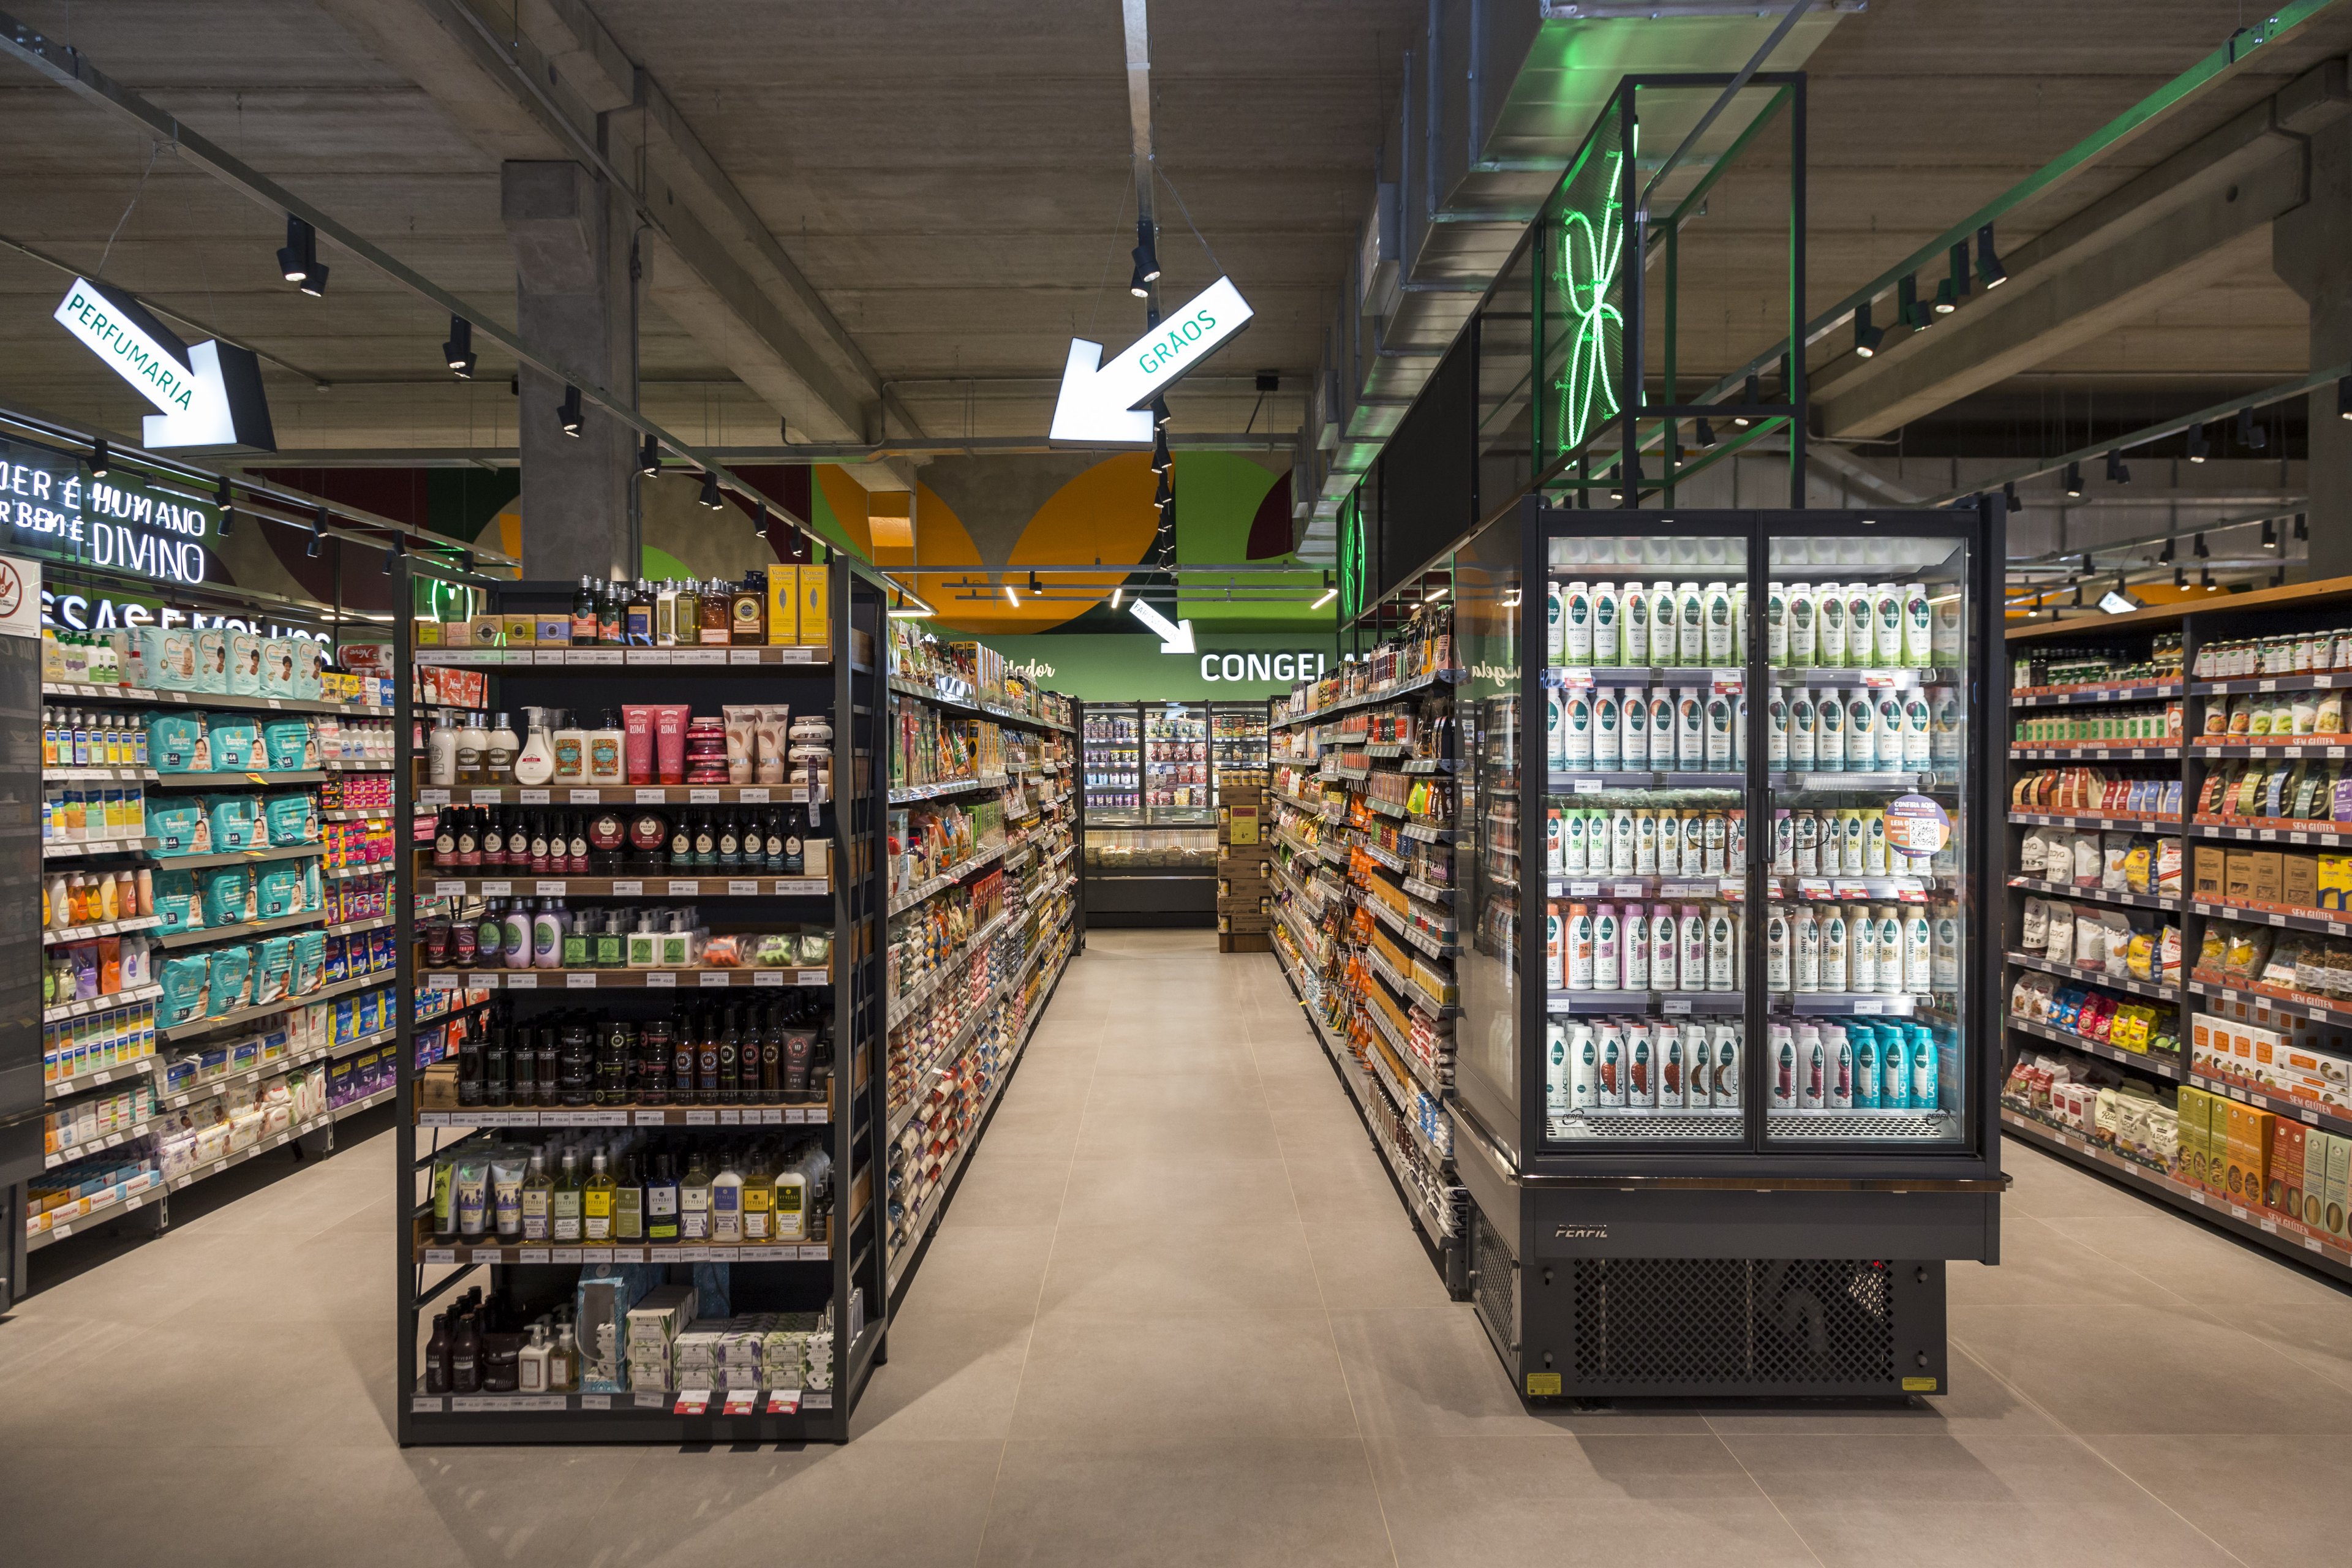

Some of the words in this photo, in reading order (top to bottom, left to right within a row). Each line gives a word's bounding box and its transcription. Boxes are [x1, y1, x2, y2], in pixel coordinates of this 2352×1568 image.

[1139, 309, 1216, 374] GRÃOS
[67, 294, 193, 411] PERFUMARIA
[64, 476, 81, 510] É
[92, 483, 205, 537] HUMANO
[16, 502, 64, 537] BEM
[70, 516, 84, 541] É
[93, 522, 205, 584] DIVINO
[349, 647, 373, 658] Neve
[1200, 653, 1372, 681] CONGEL
[630, 723, 646, 734] ROMÃ
[661, 723, 677, 734] ROMÃ
[225, 735, 247, 746] Pampers
[166, 818, 190, 829] Pampers
[2293, 821, 2307, 830] SEM
[2309, 823, 2335, 832] GLÚTEN
[2291, 908, 2306, 917] SEM
[2308, 910, 2334, 921] GLÚTEN
[2291, 992, 2303, 1003] SEM
[2306, 995, 2333, 1009] GLÚTEN
[2289, 1095, 2302, 1105] SEM
[2305, 1099, 2331, 1115] GLÚTEN
[1556, 1224, 1608, 1238] PERFIL
[2267, 1212, 2282, 1224] SEM
[2282, 1218, 2309, 1235] GLÚTEN
